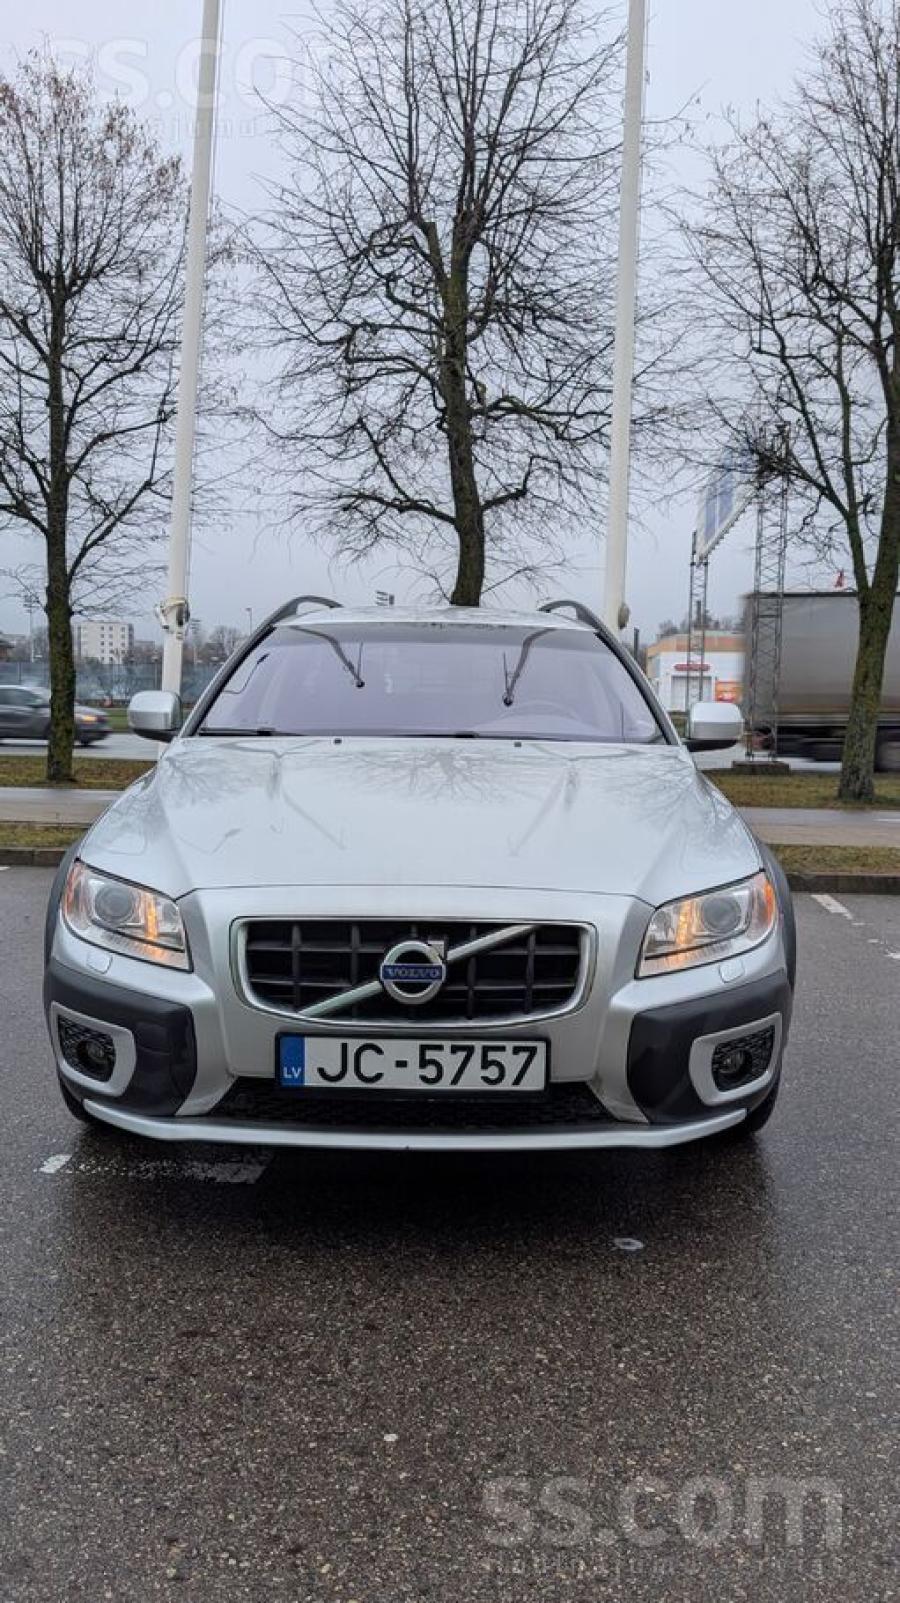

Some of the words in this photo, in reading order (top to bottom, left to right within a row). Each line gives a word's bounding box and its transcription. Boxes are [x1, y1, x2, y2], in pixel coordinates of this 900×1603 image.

[385, 967, 440, 978] VOLVO
[283, 1067, 301, 1078] LV
[316, 1042, 538, 1085] JC-5757
